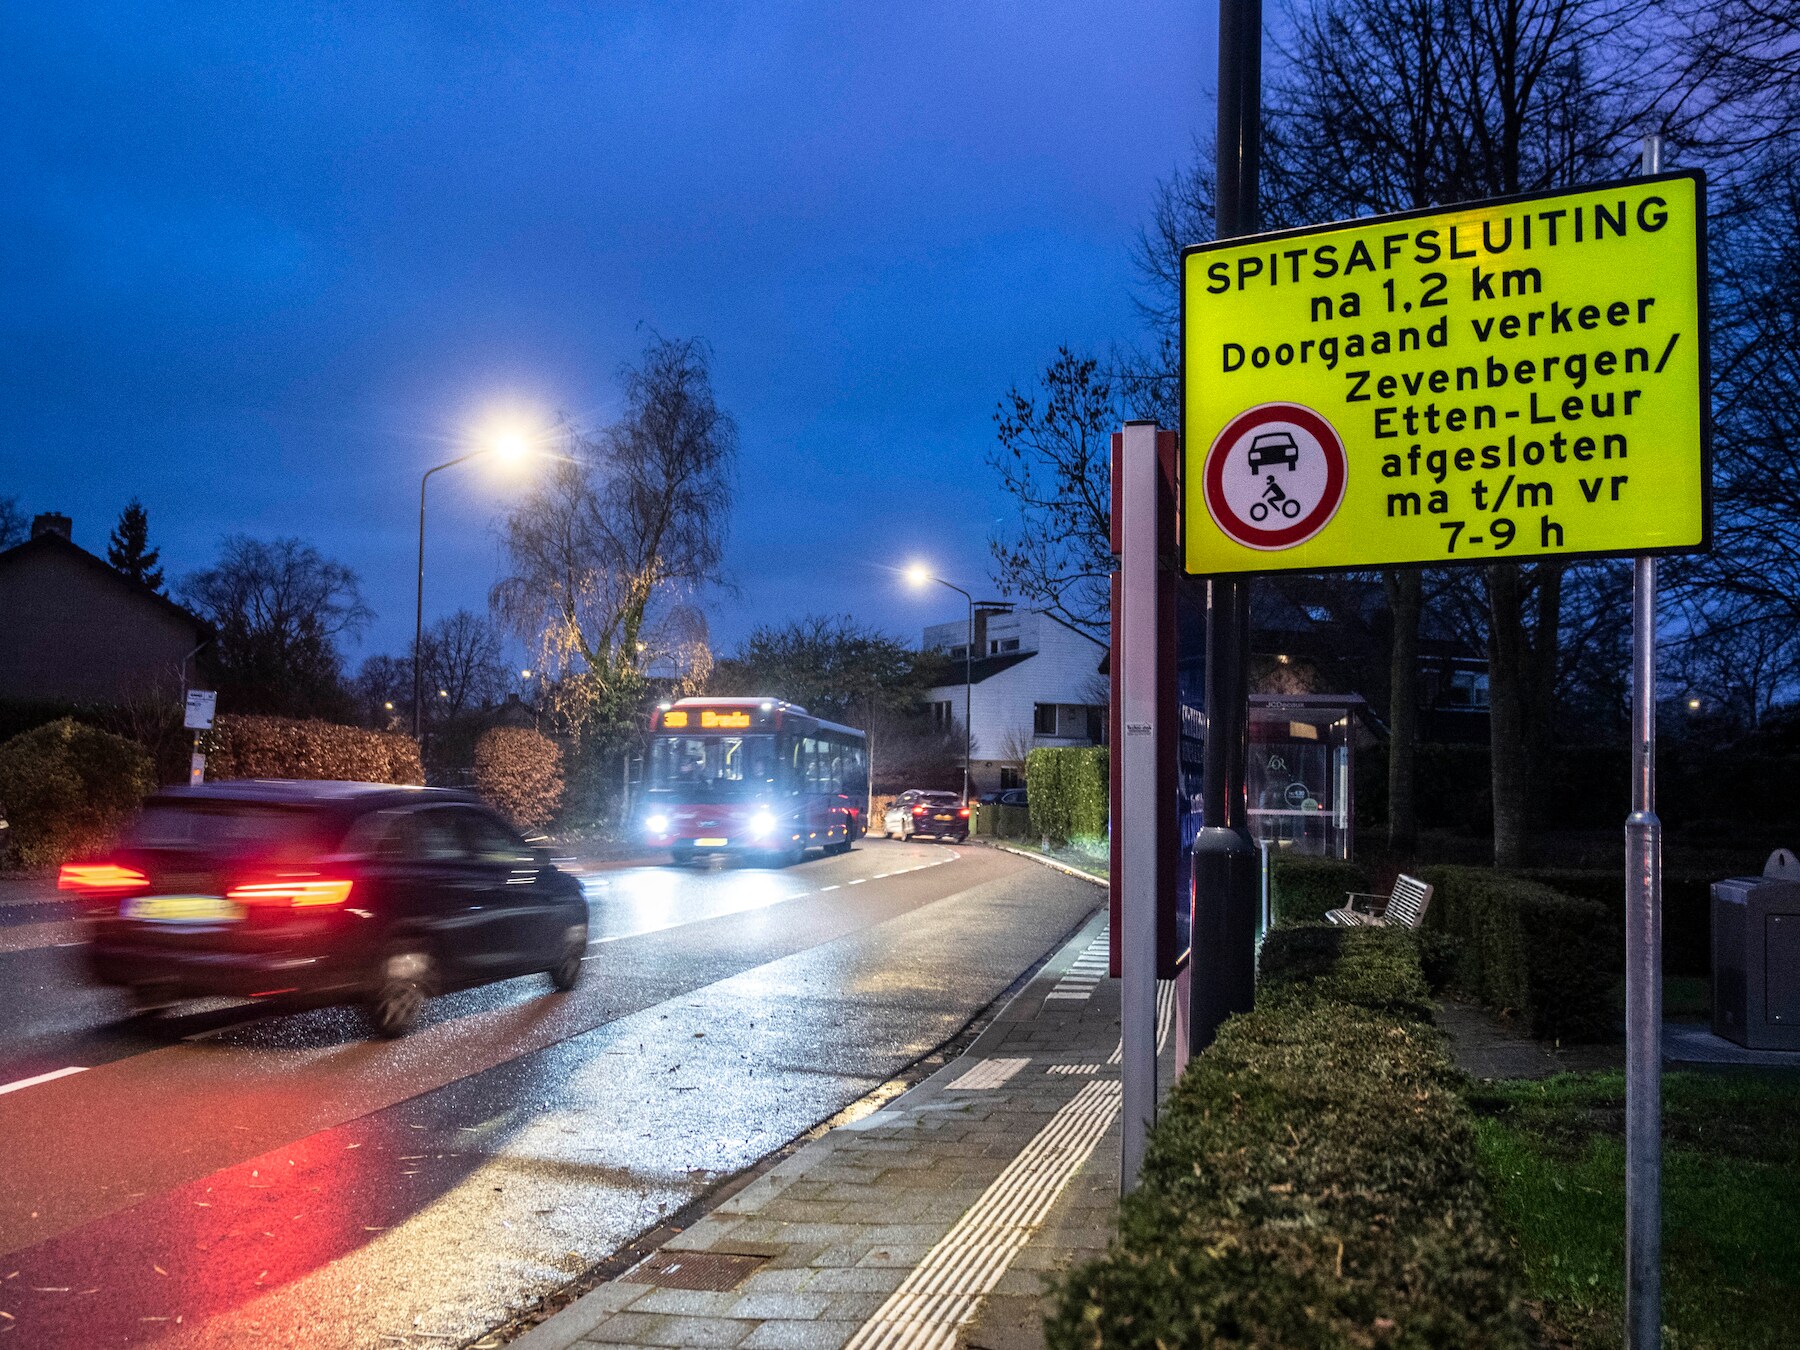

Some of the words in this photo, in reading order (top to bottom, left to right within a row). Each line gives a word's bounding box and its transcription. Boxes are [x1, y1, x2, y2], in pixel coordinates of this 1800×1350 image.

[1206, 195, 1669, 295] SPITSAFSLUITING
[1310, 291, 1361, 323] na
[1382, 272, 1448, 314] 1,2
[1472, 265, 1542, 302] km
[1222, 314, 1448, 373] Doorgaand
[1470, 297, 1656, 343] verkeer
[1345, 332, 1681, 403] Zevenbergen/
[1374, 389, 1642, 440] Etten-Leur
[1381, 431, 1628, 485] afgesloten
[1386, 489, 1449, 518] ma
[1471, 474, 1553, 513] t/m
[1578, 475, 1629, 503] vr
[1439, 517, 1517, 554] 7-9
[1540, 514, 1564, 548] h
